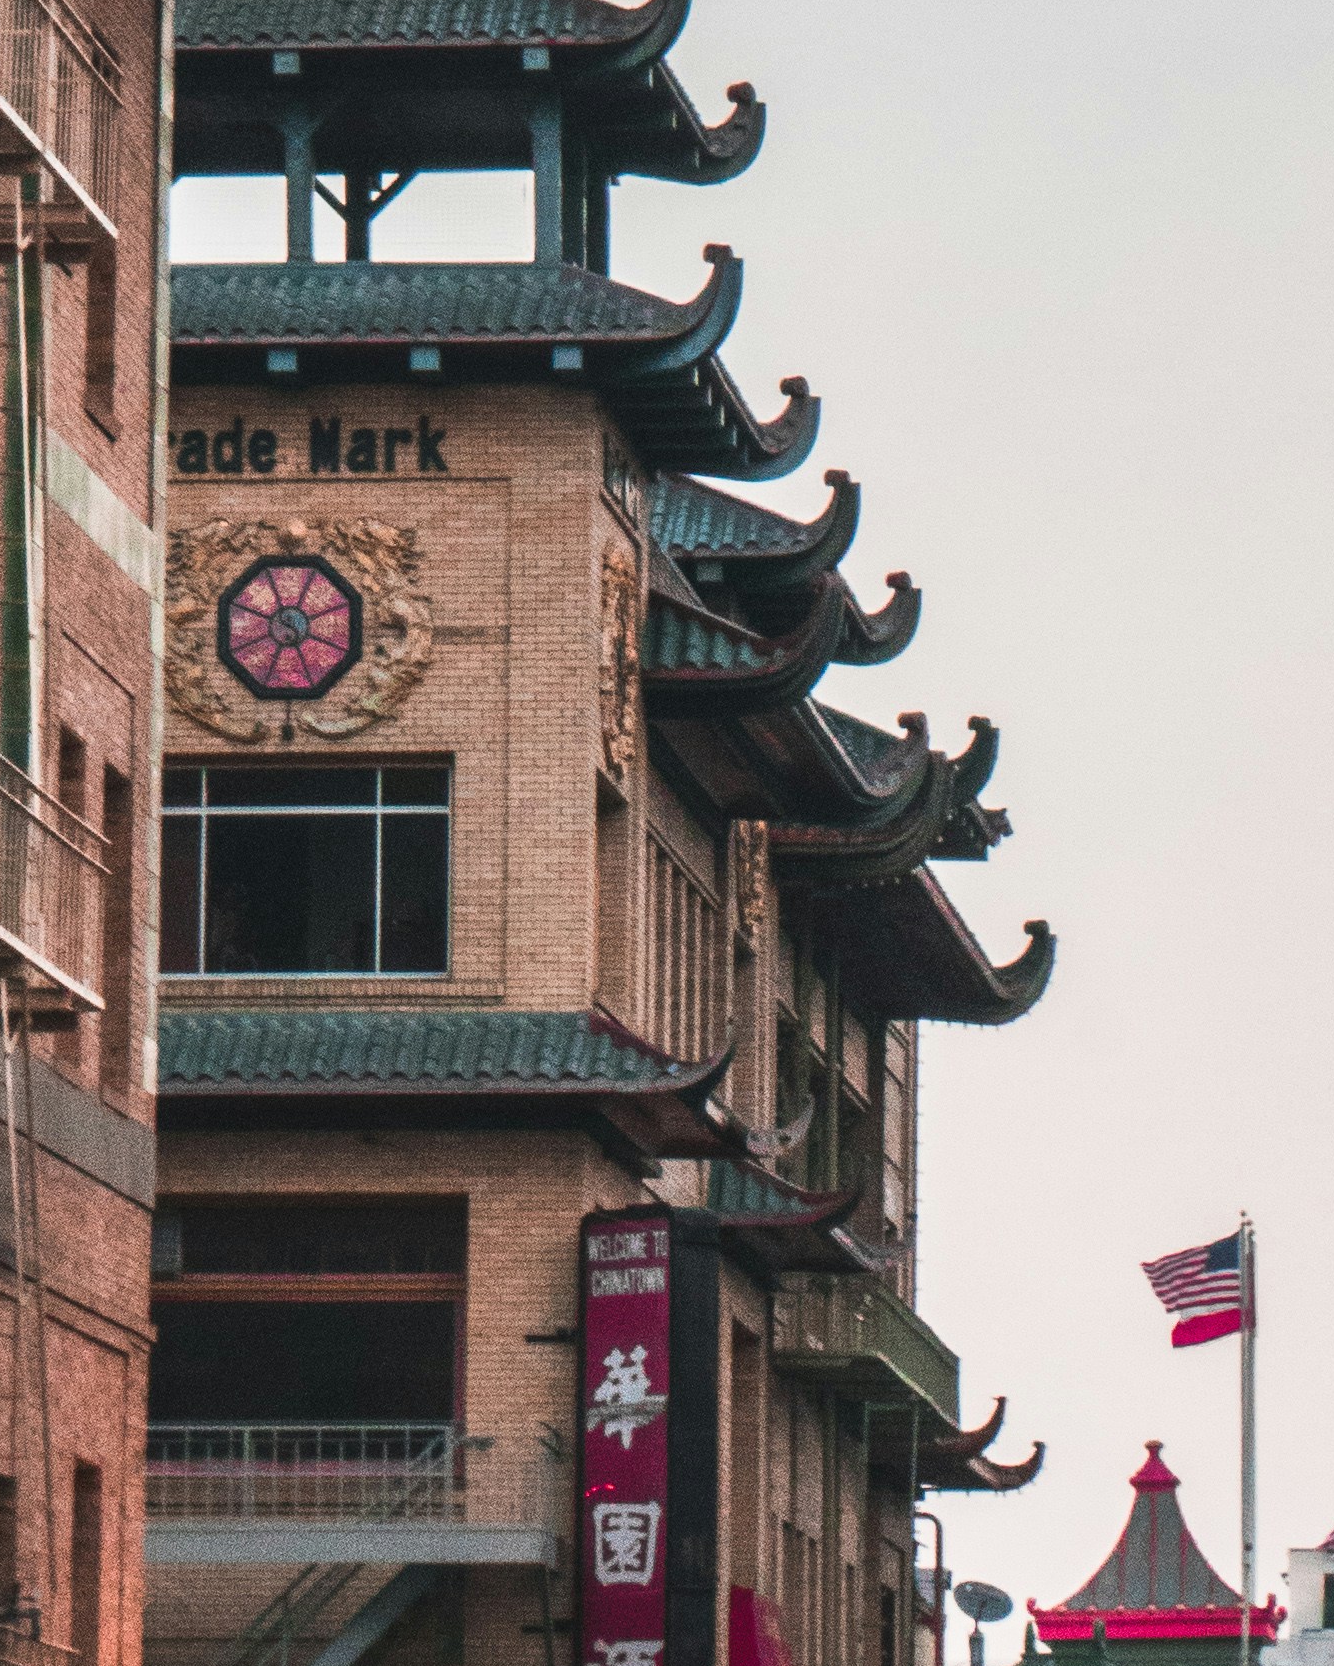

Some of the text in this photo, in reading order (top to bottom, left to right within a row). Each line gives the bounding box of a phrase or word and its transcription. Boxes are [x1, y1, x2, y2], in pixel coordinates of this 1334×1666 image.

[308, 414, 450, 475] Mark
[587, 1230, 668, 1261] WELCOME TO
[590, 1267, 666, 1298] CHINATOWN
